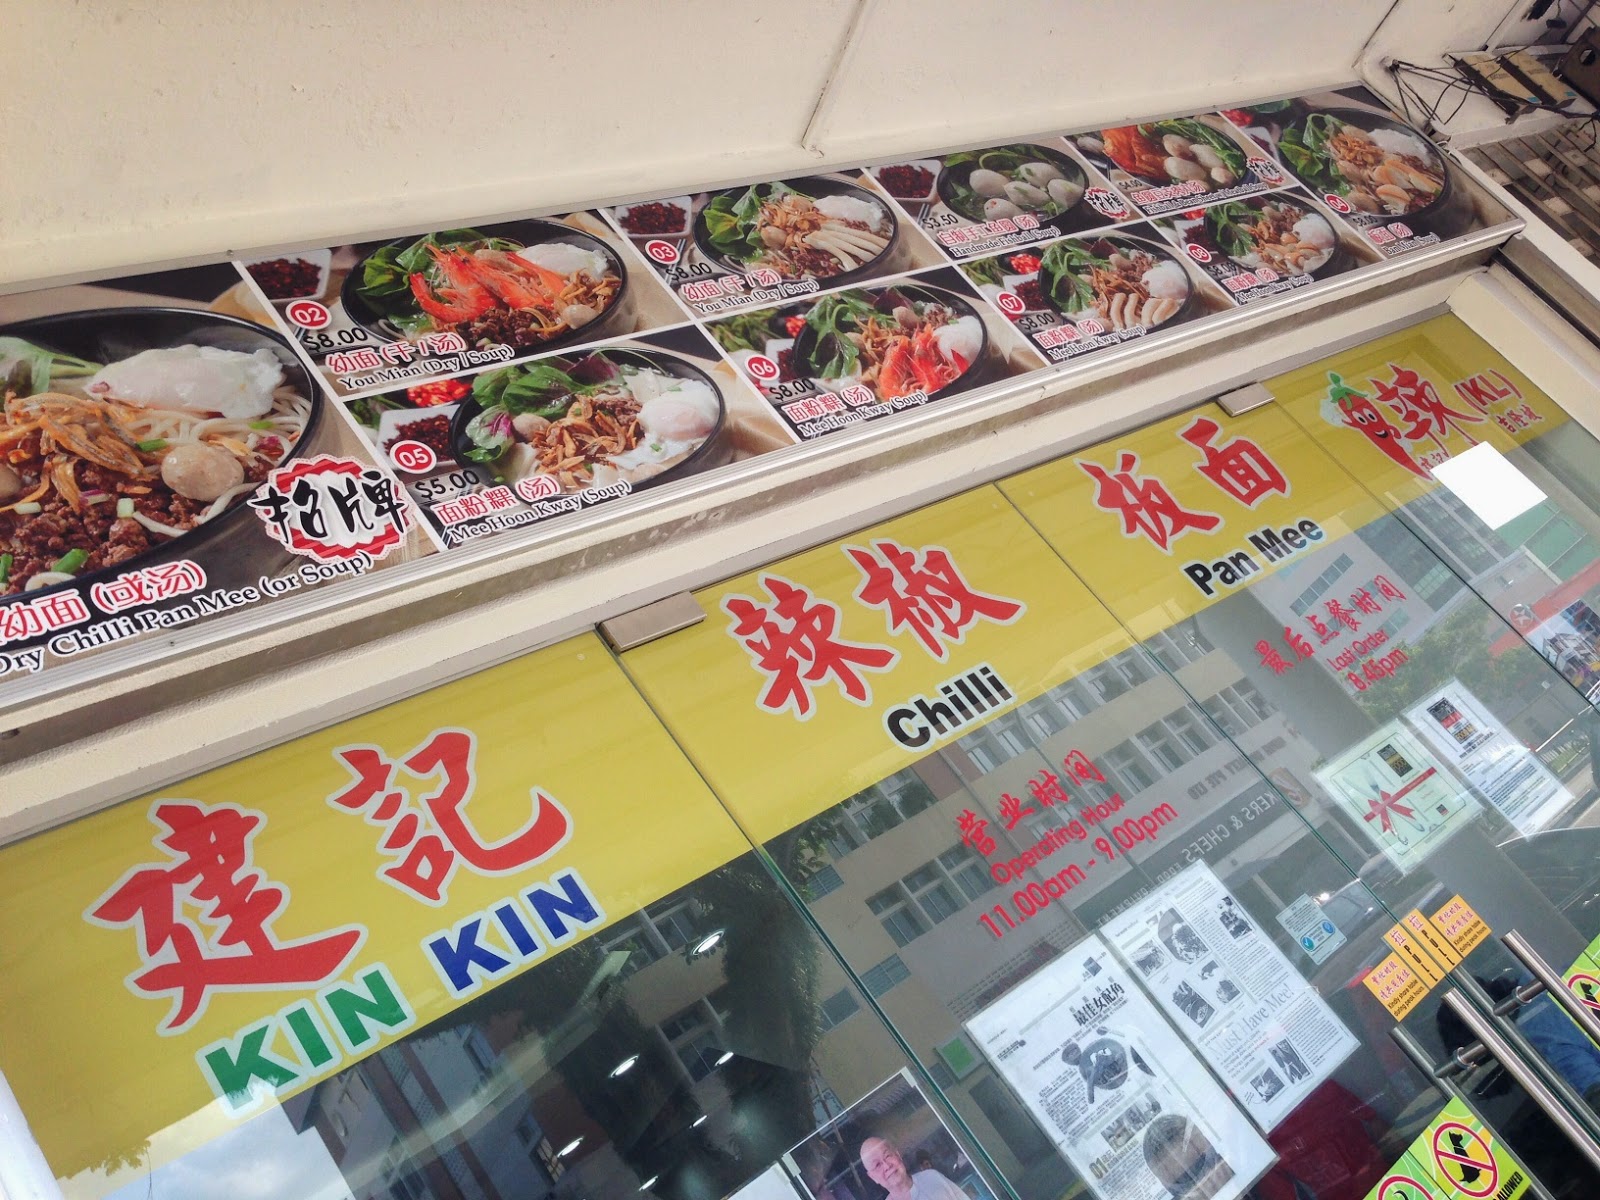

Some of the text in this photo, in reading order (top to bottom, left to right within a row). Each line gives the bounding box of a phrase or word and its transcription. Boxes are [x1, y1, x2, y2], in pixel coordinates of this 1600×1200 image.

[924, 214, 958, 230] $3.50
[651, 245, 675, 260] 03
[952, 225, 1061, 257] Handmade Fishball (Soup)
[1383, 245, 1399, 255] Ban
[666, 262, 713, 280] $8.00
[293, 305, 326, 325] 02
[695, 299, 721, 313] You
[723, 293, 751, 308] Mian
[1002, 295, 1020, 310] 07
[1019, 312, 1055, 331] $8.00
[303, 327, 368, 352] $8.00
[1049, 324, 1147, 360] Mee Hoon Kway (Soup)
[340, 373, 374, 390] You
[377, 365, 420, 383] Mian
[751, 360, 775, 376] 06
[769, 378, 816, 401] $8.00
[1455, 370, 1522, 415] (KL)
[798, 391, 928, 437] Mee Hoon Kway (Soup)
[399, 447, 430, 468] 05
[415, 470, 480, 501] $5.00
[251, 471, 405, 543] 招牌
[450, 479, 632, 543] Mee Hoon Kway (Soup)
[51, 618, 136, 655] Chilli
[139, 604, 192, 632] Pan
[200, 586, 258, 614] Mee
[262, 574, 301, 597] (or
[301, 551, 373, 585] Soup)
[1327, 629, 1389, 671] Last Order
[205, 520, 1323, 1110] KIN KIN Chilli Pan Mee
[957, 749, 1107, 856] 营业时间
[991, 793, 1125, 884] Operating Hour
[980, 864, 1086, 938] 11.00am
[1095, 803, 1178, 861] 9.00pm
[1421, 929, 1455, 966] PULL
[1453, 935, 1465, 946] Kindly
[1460, 941, 1471, 953] during
[1404, 944, 1438, 981] PULL
[1261, 983, 1293, 1011] Mee!
[1387, 979, 1418, 1009] Kindly share table
[1393, 1004, 1407, 1017] during
[1404, 995, 1416, 1007] peak
[1498, 1171, 1524, 1200] ALLOWED
